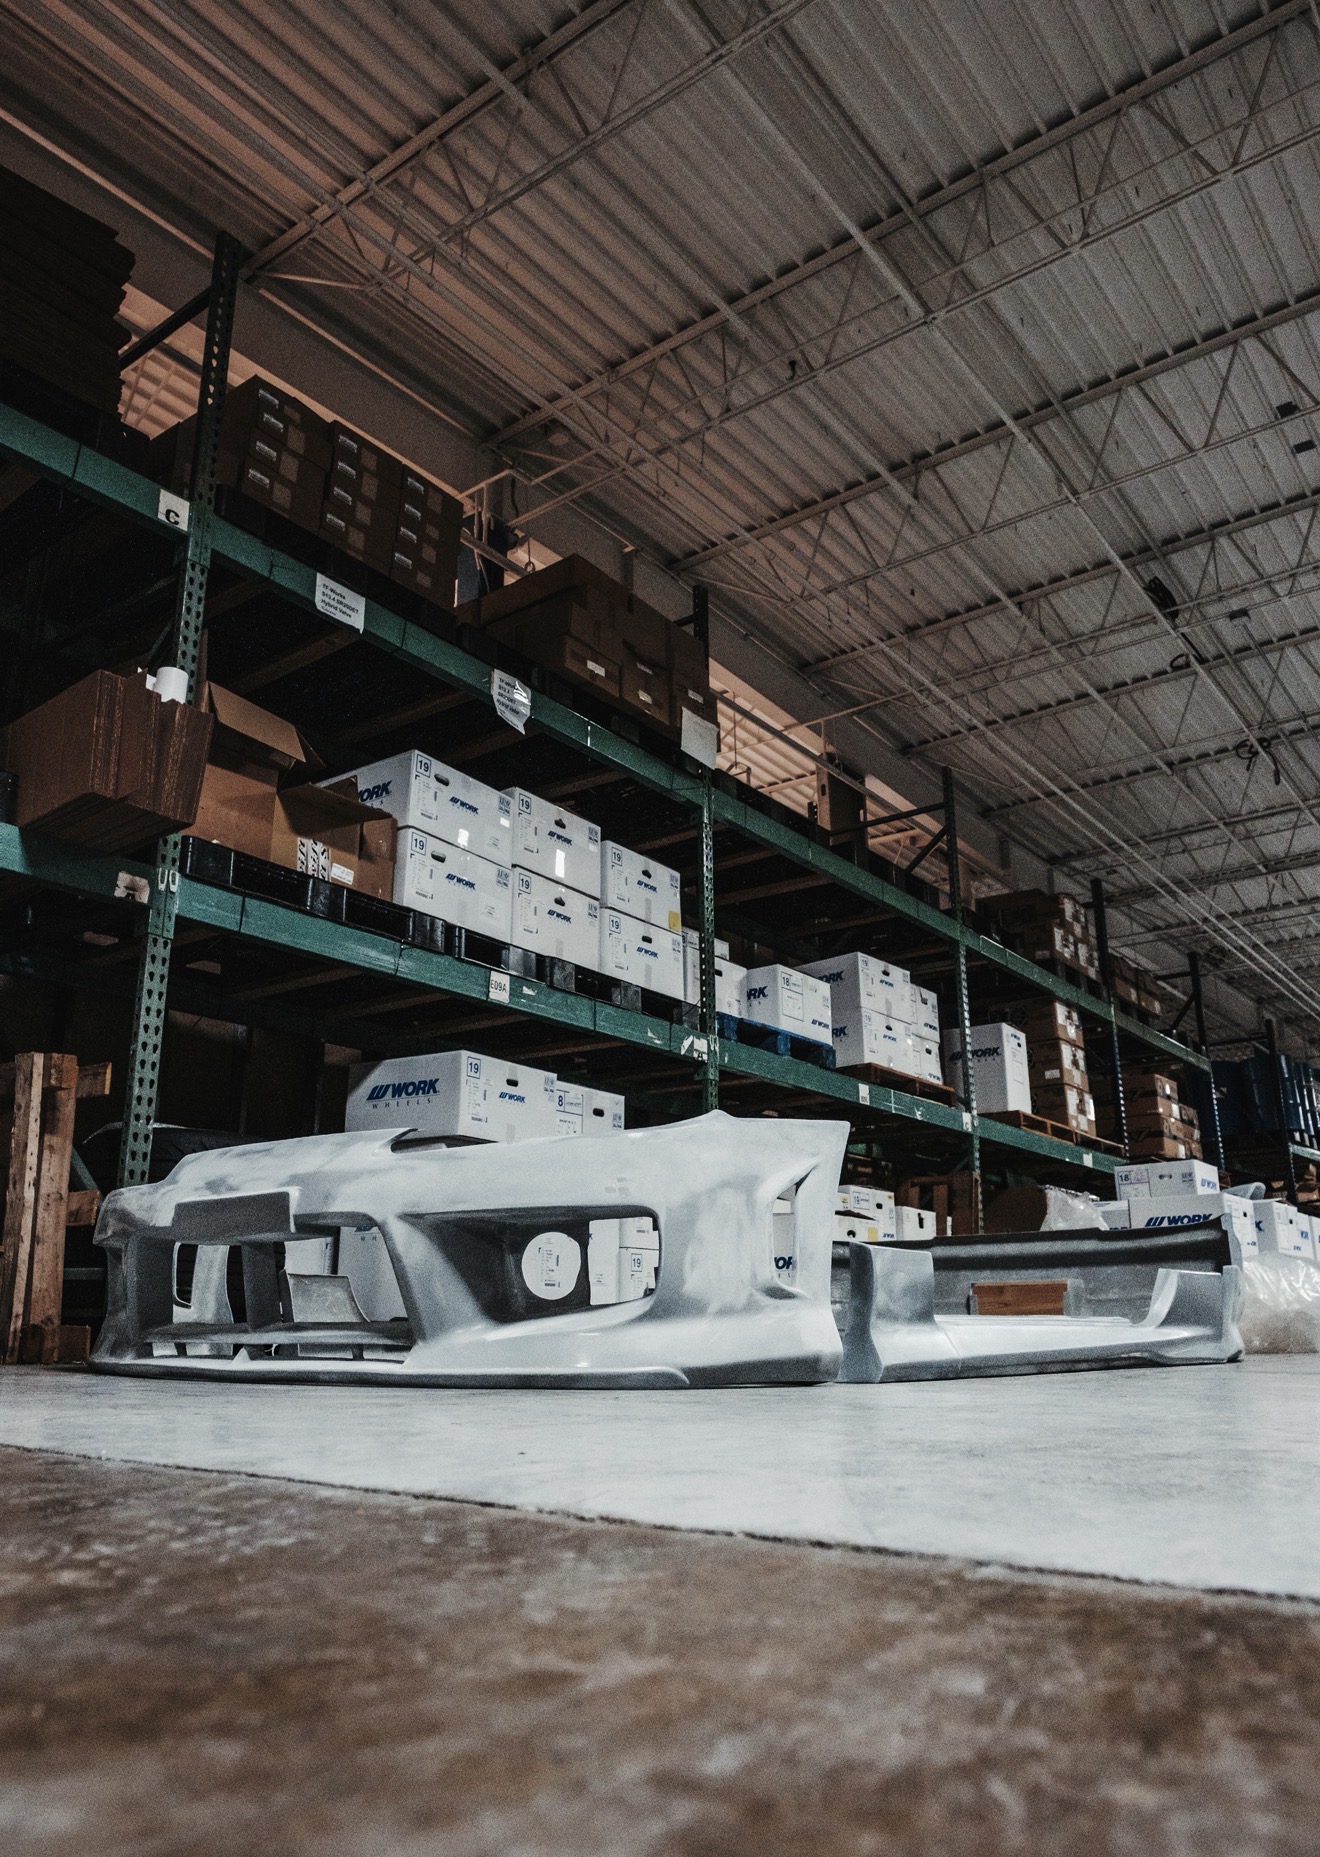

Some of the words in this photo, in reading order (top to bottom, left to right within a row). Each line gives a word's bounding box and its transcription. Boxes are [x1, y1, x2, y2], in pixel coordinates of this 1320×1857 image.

[165, 508, 180, 526] C
[418, 759, 430, 773] 19
[520, 798, 530, 810] 19
[413, 838, 425, 851] 19
[612, 851, 621, 862] 19
[520, 878, 530, 890] 19
[610, 918, 620, 931] 19
[781, 976, 790, 987] 18
[747, 986, 768, 1001] RK
[832, 1026, 847, 1038] RK
[468, 1061, 480, 1075] 19
[391, 1078, 440, 1099] WORK
[372, 1098, 431, 1109] WHEELS
[1119, 1174, 1130, 1182] 18
[1167, 1213, 1213, 1226] WORK
[632, 1257, 642, 1268] 19
